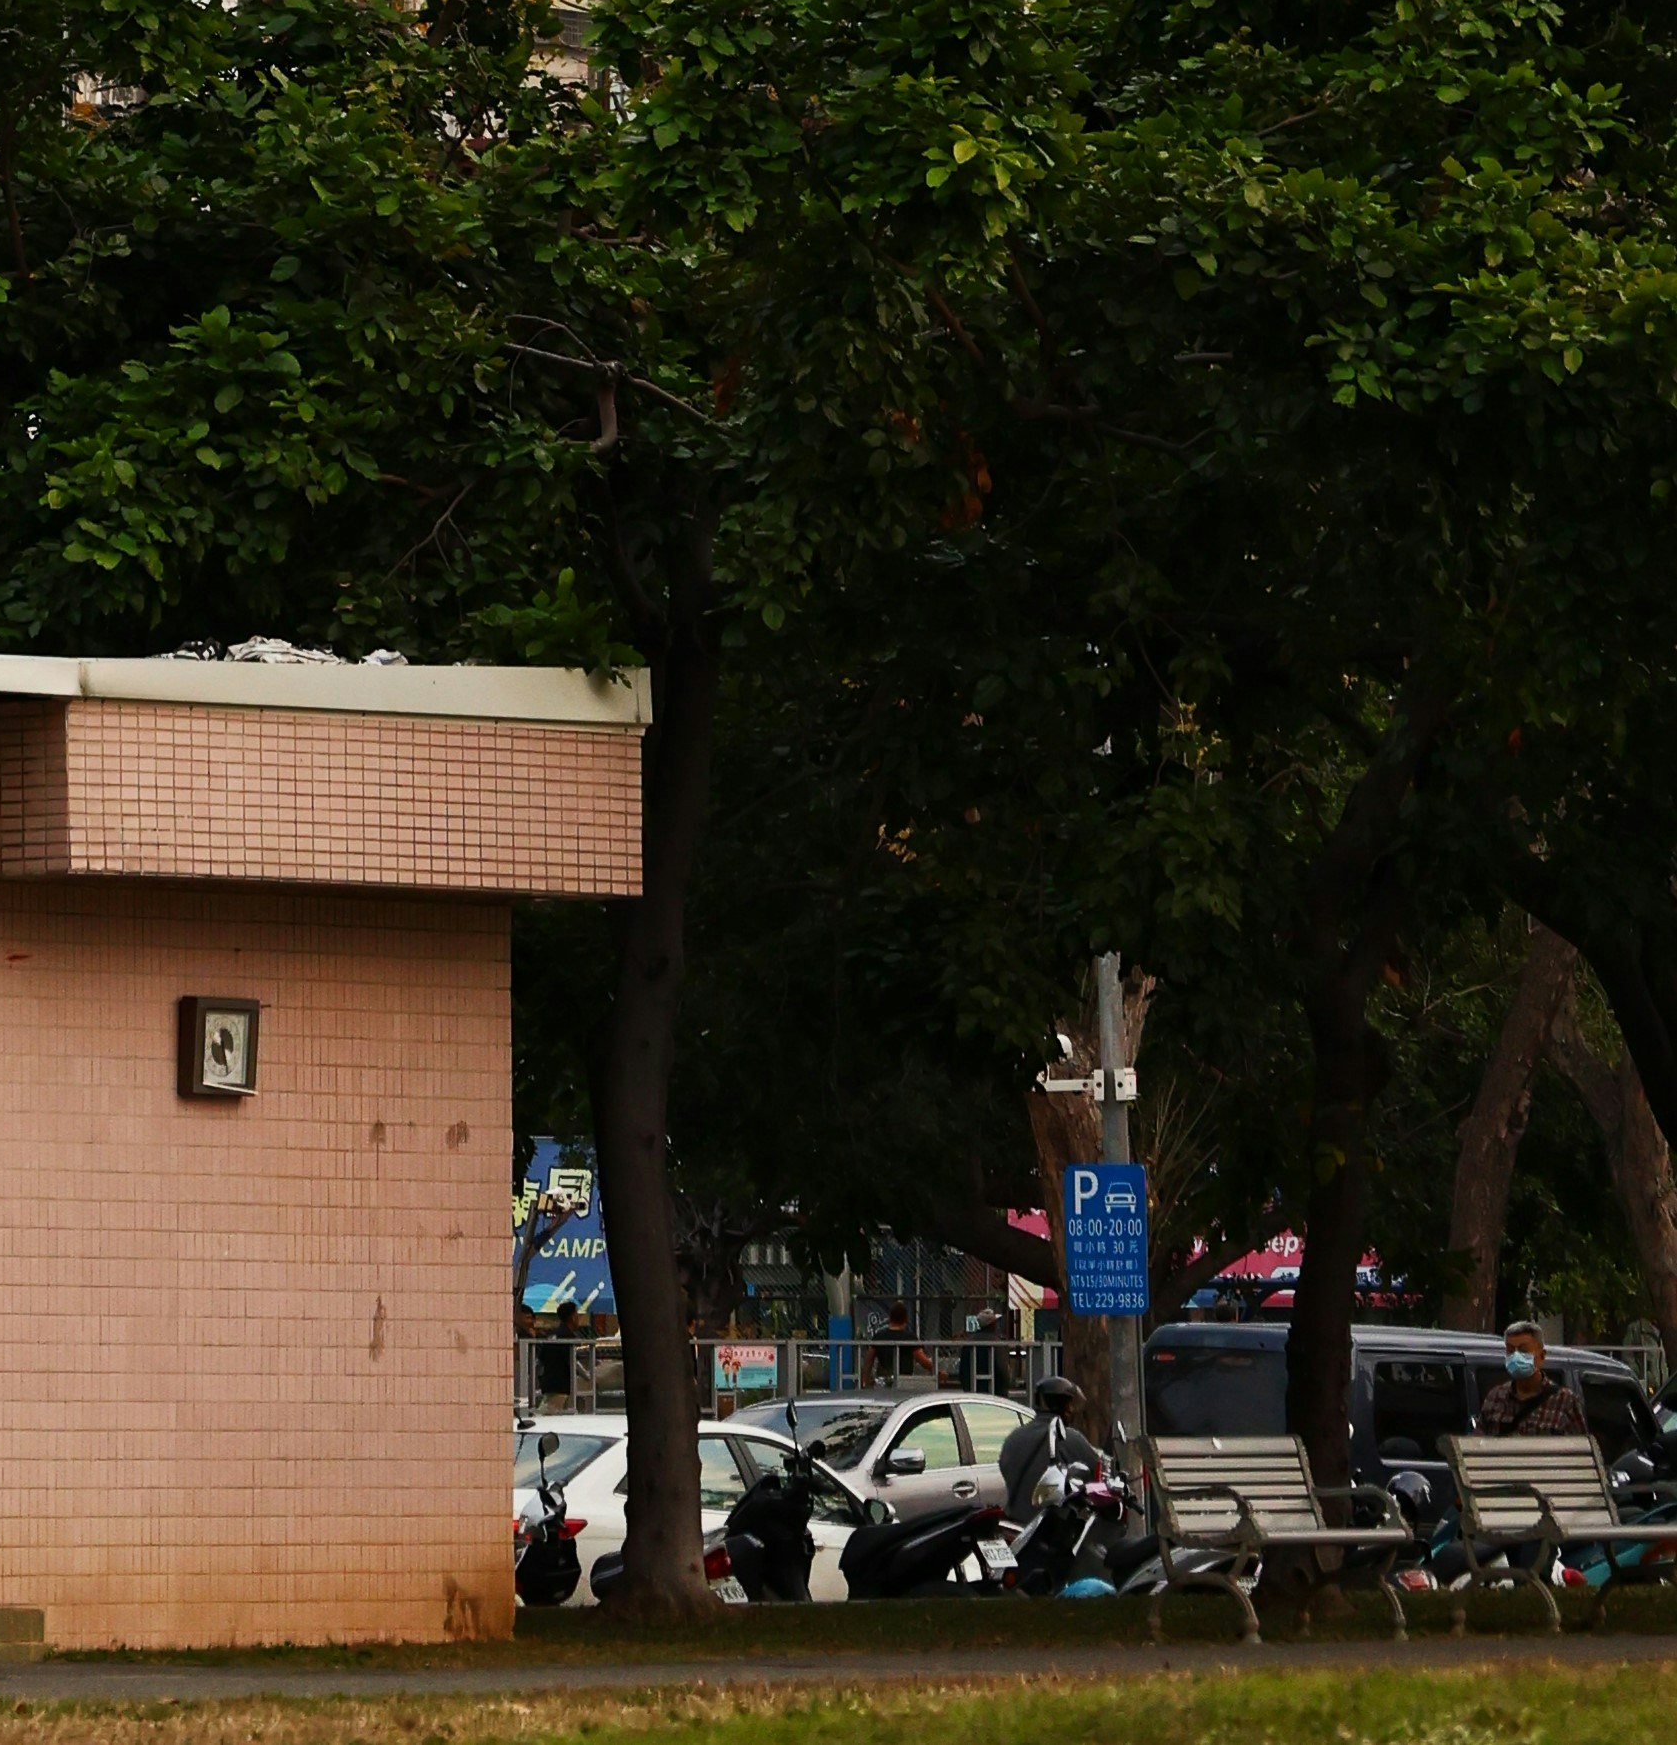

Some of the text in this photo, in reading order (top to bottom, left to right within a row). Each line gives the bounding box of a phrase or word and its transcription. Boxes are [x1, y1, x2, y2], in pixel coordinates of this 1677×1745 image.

[1074, 1170, 1099, 1215] P
[1068, 1218, 1143, 1237] 08:00-20:00
[1112, 1240, 1125, 1255] 30
[1072, 1292, 1145, 1309] TEL:229-9836
